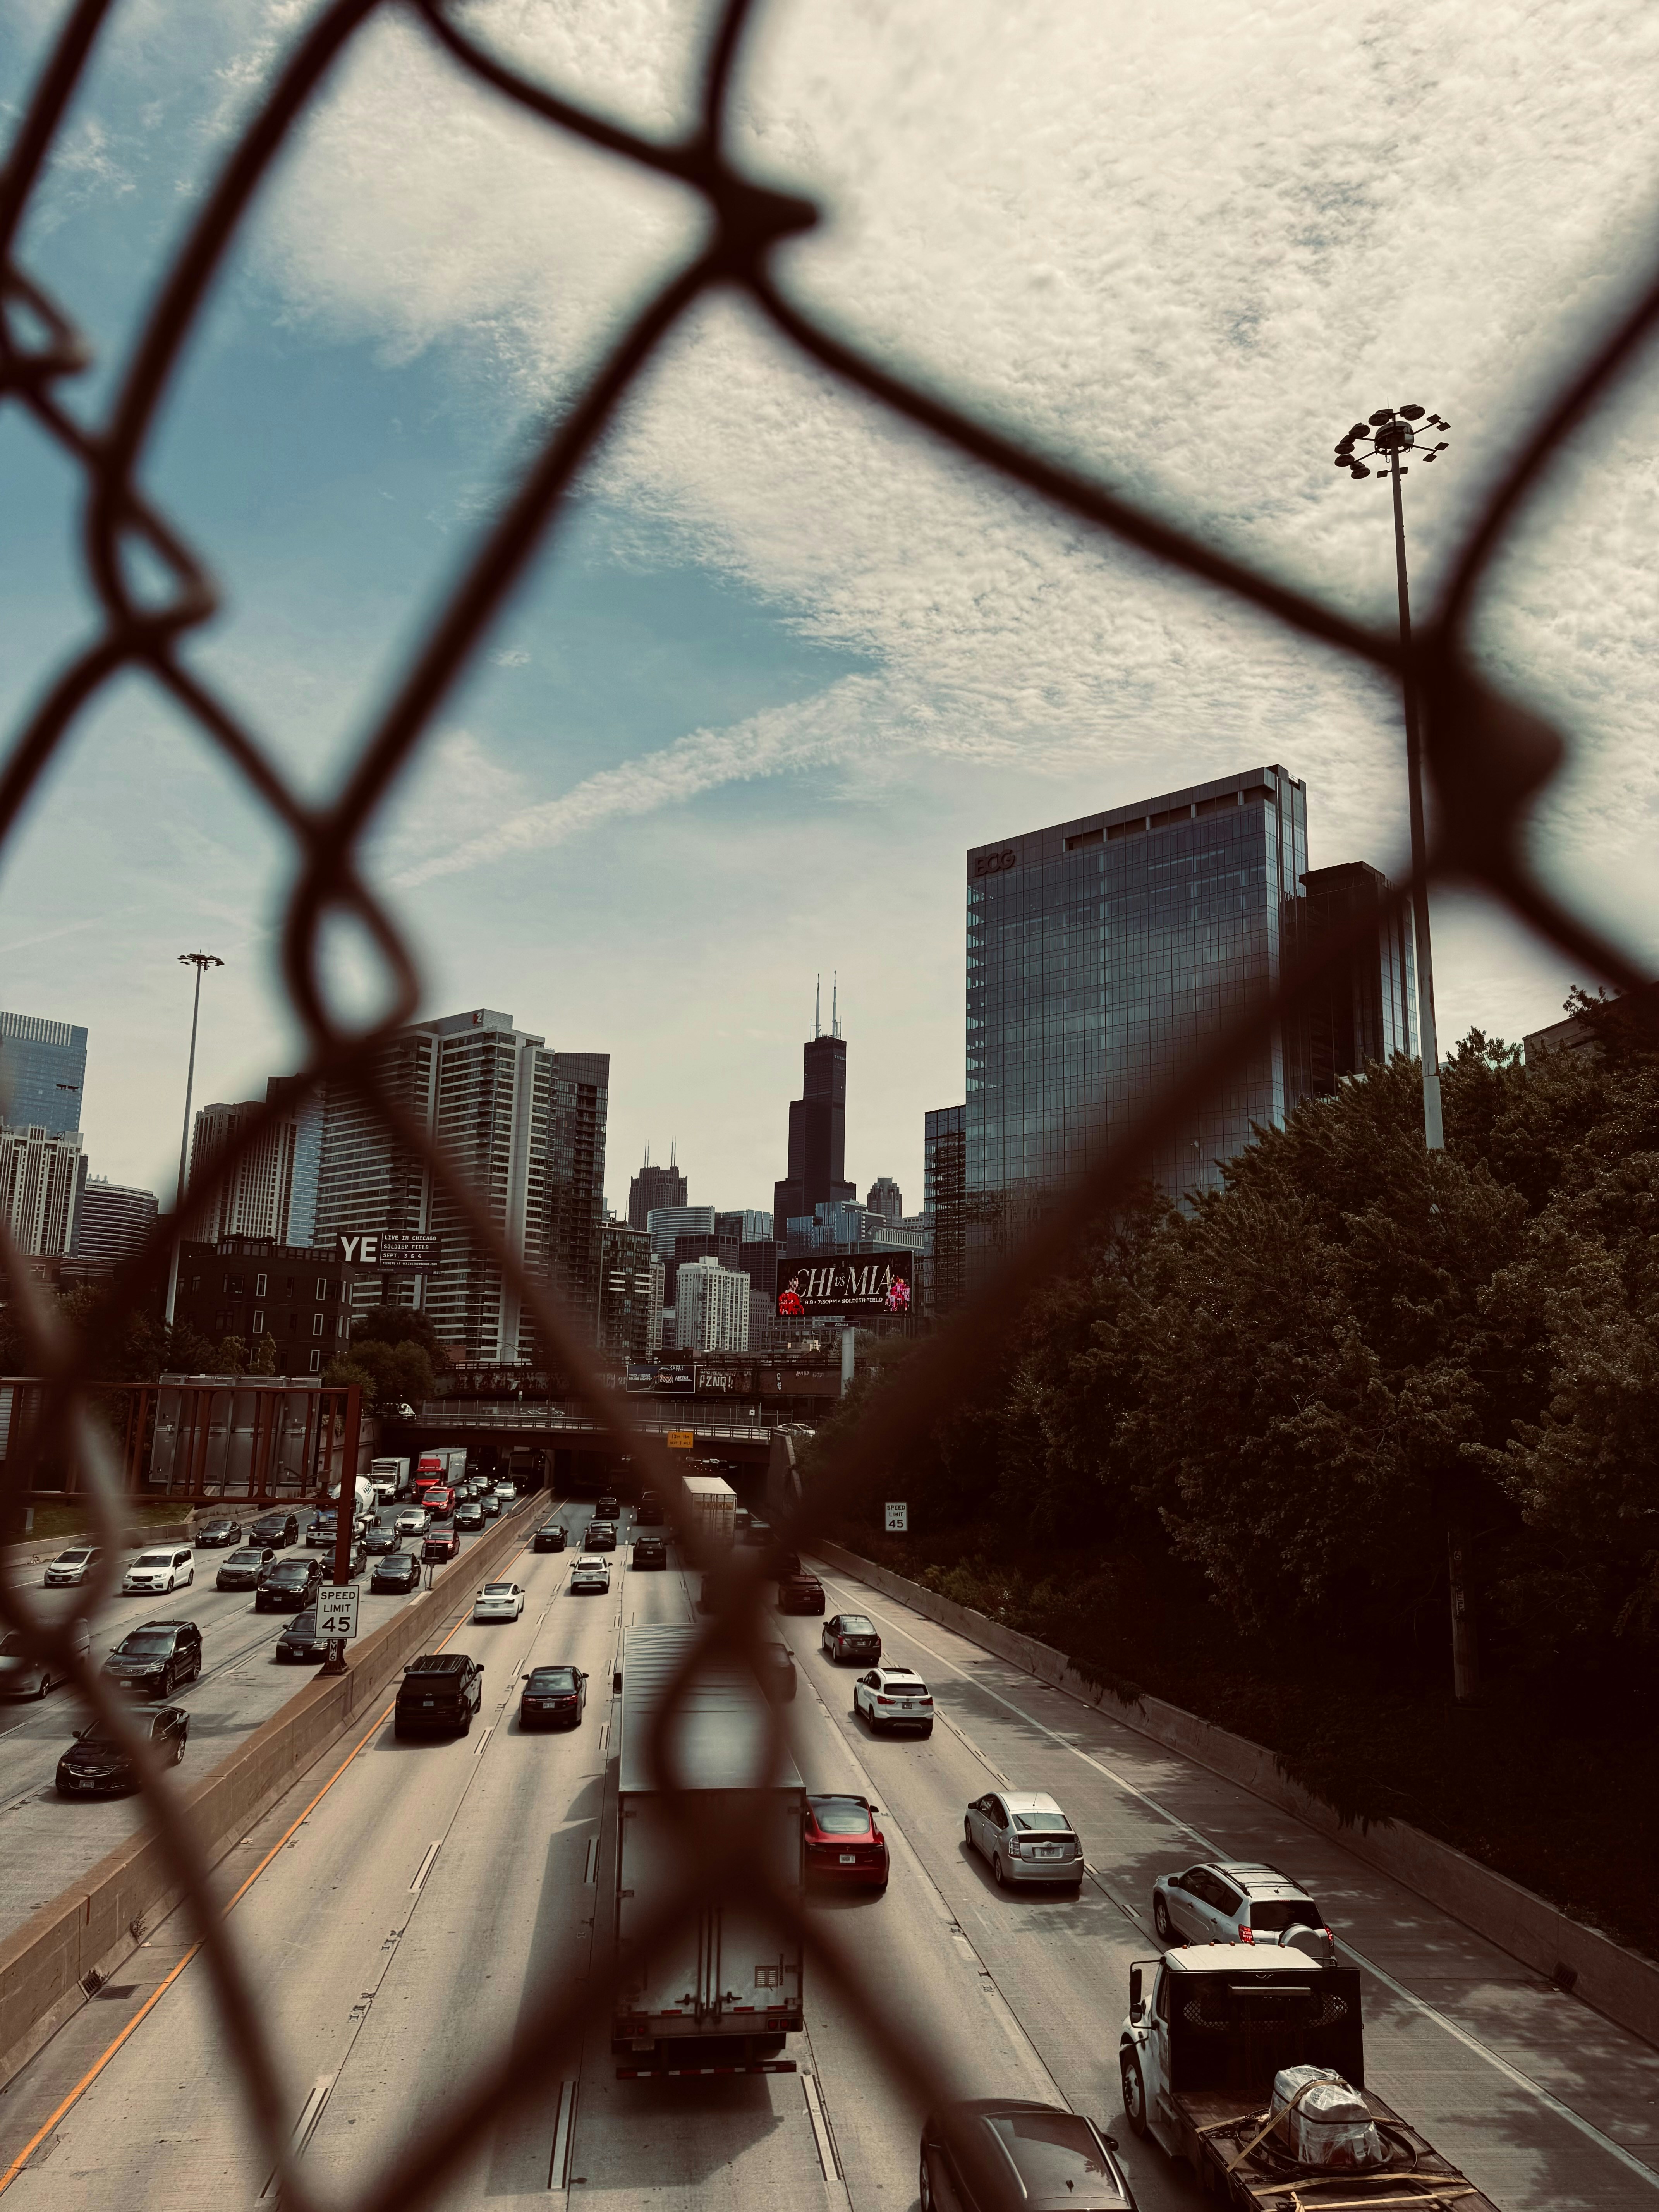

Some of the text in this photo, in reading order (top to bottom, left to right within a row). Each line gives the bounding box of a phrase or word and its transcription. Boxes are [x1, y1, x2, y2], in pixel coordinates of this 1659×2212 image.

[975, 849, 1015, 877] BCG
[340, 1236, 378, 1262] YE
[797, 1268, 836, 1297] CHI
[843, 1264, 891, 1296] MIA
[888, 1519, 903, 1528] 45
[1455, 1551, 1460, 1559] 6
[321, 1592, 356, 1600] SPEED
[324, 1604, 351, 1612] LIMIT
[322, 1616, 350, 1632] 45
